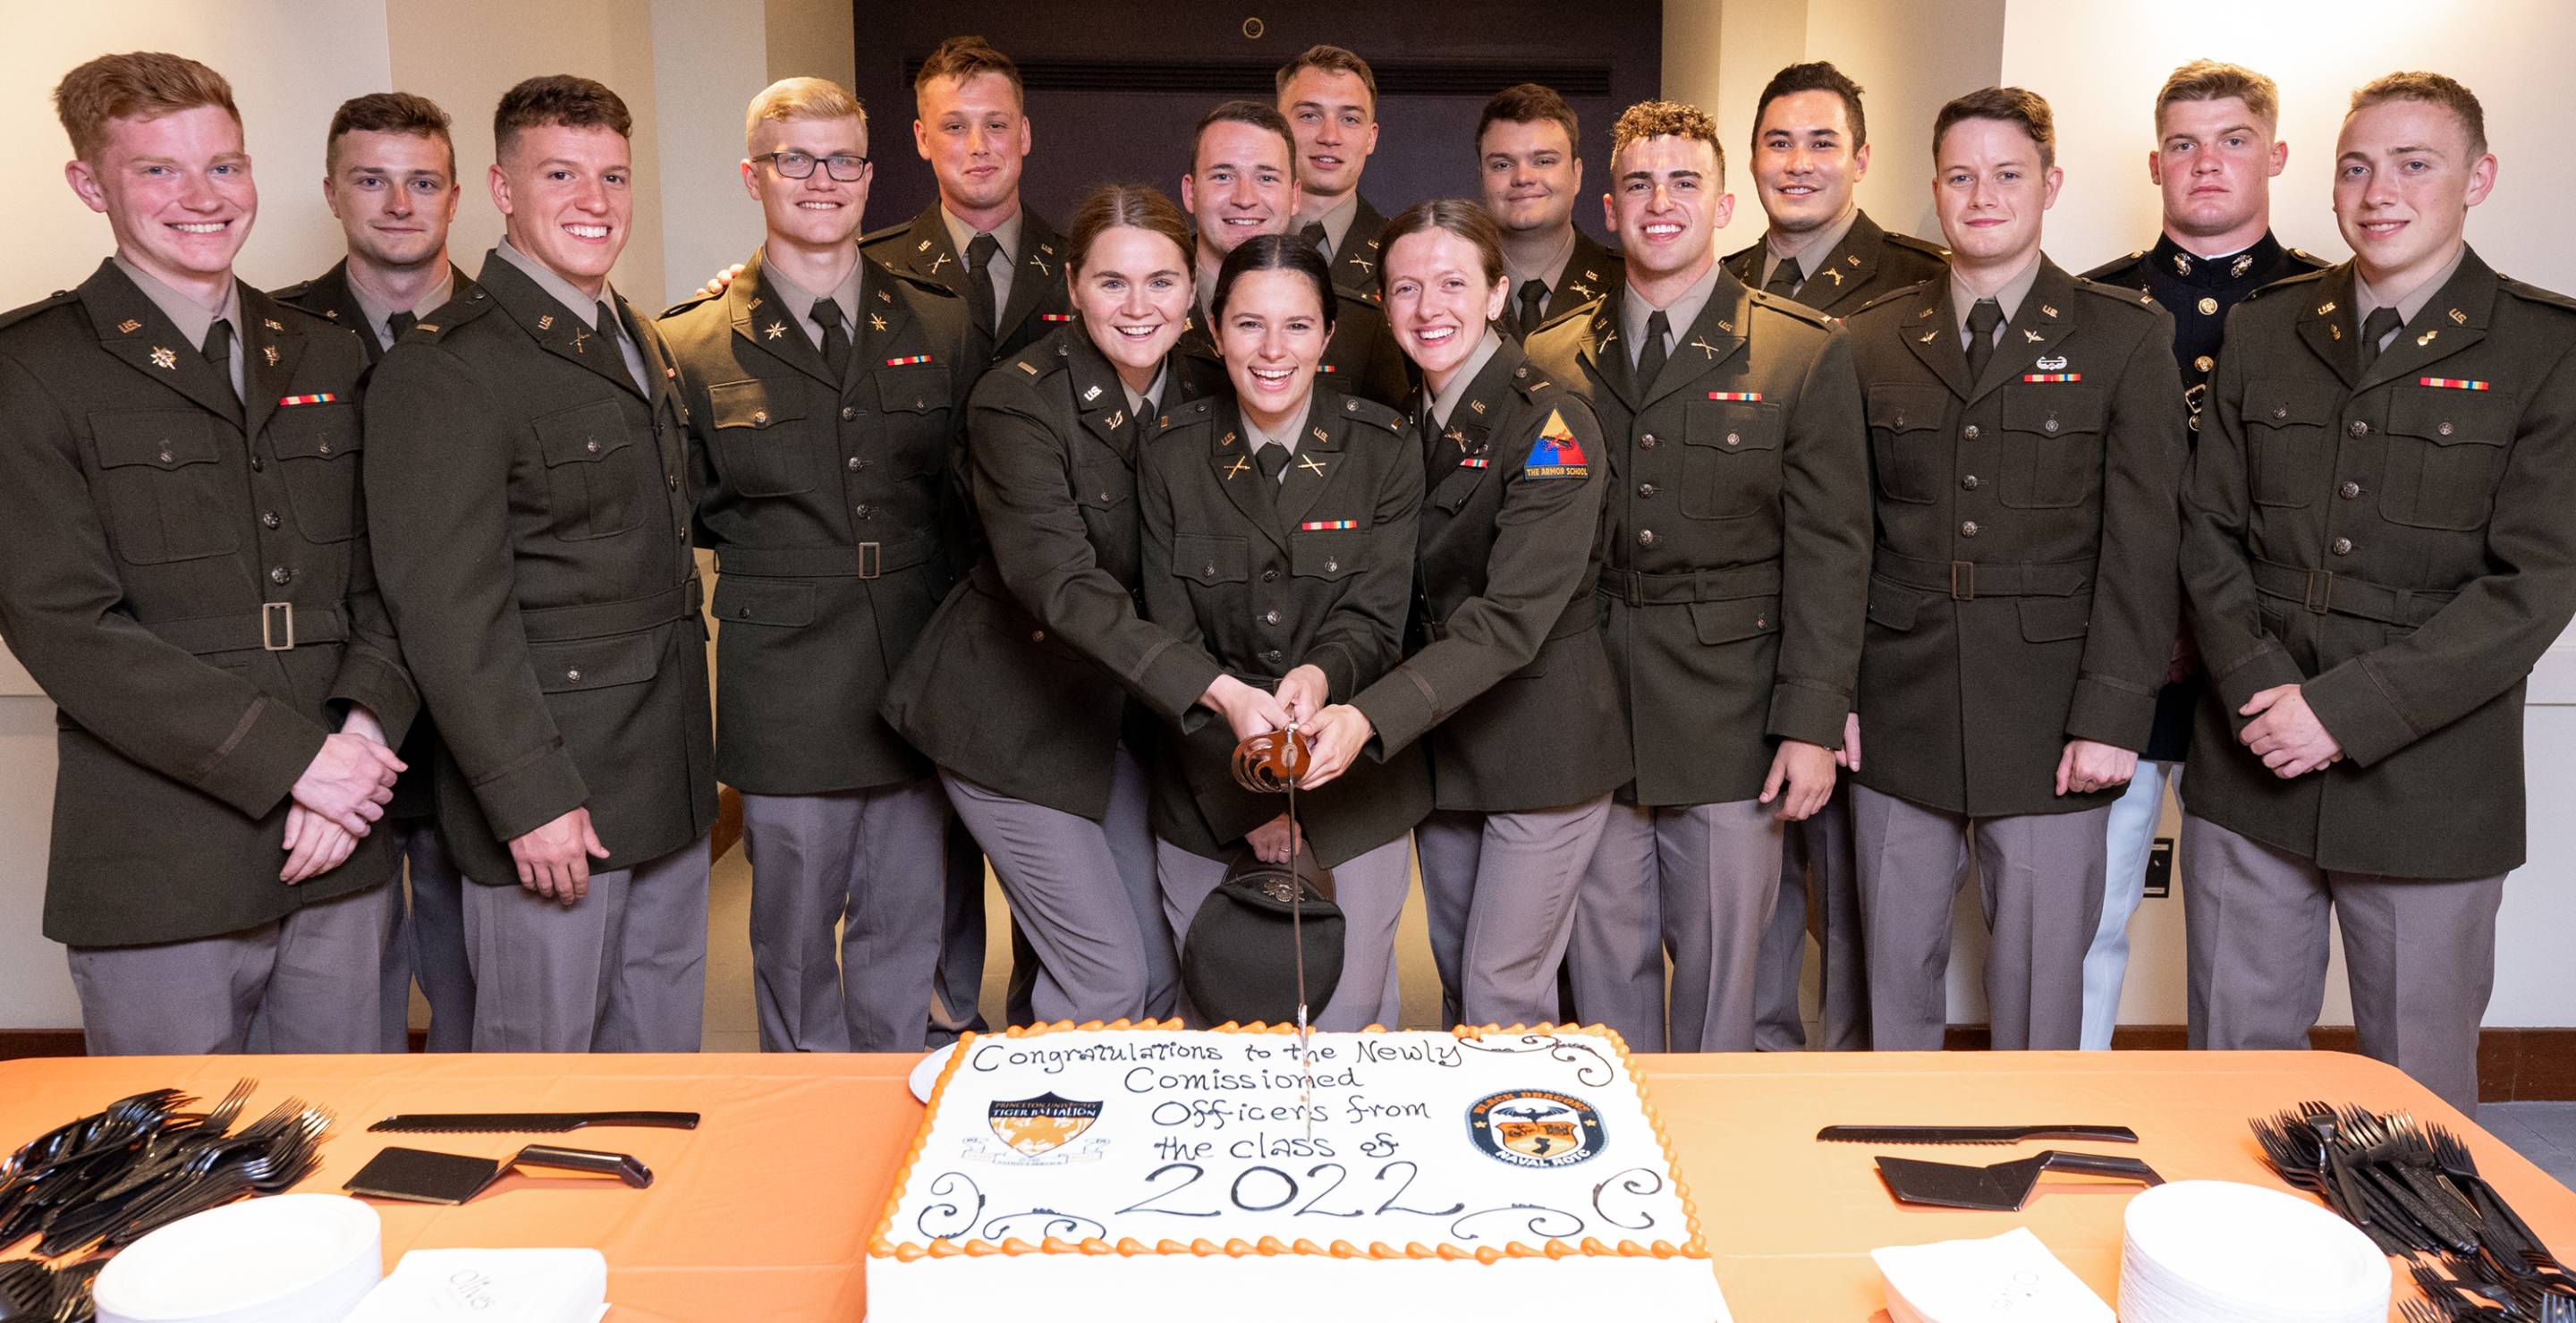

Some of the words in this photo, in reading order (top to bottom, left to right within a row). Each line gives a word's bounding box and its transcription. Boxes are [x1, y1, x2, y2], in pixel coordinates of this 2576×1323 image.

[1527, 468, 1539, 476] THE
[1541, 467, 1564, 476] ARMOR
[1566, 467, 1588, 476] SCHOOL
[973, 1041, 1223, 1073] Congratulations
[1245, 1043, 1271, 1062] to
[1356, 1039, 1462, 1067] Newly
[1124, 1066, 1364, 1093] Comissioned
[993, 1108, 1028, 1116] TIGER
[1152, 1099, 1328, 1130] Officers
[1346, 1095, 1431, 1124] from
[1473, 1092, 1516, 1114] BLACK
[1154, 1136, 1213, 1161] the
[1230, 1132, 1335, 1158] class
[1360, 1132, 1399, 1158] of
[1496, 1150, 1548, 1166] NAVAL
[1553, 1149, 1591, 1166] ROTC
[1114, 1161, 1465, 1217] 2022
